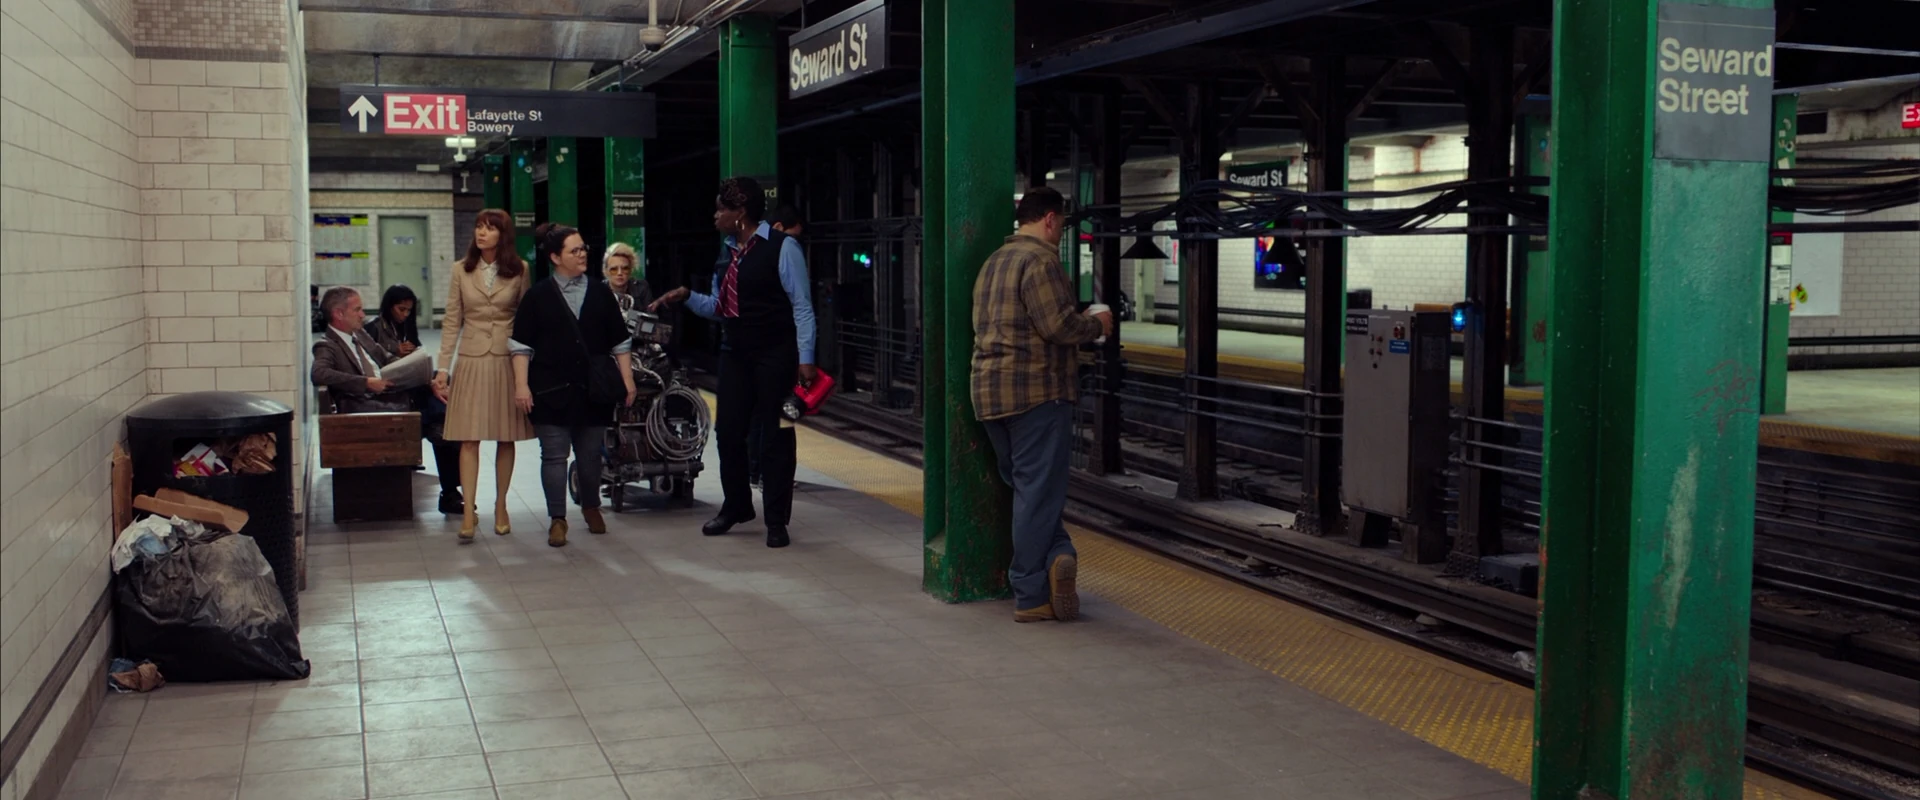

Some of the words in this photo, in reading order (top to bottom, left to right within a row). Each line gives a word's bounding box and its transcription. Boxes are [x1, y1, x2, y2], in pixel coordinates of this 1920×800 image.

[790, 30, 845, 91] Seward
[849, 23, 868, 71] St
[1659, 37, 1773, 77] Seward
[1658, 78, 1750, 115] Street
[386, 96, 461, 130] Exit
[467, 109, 525, 123] Lafayette
[529, 110, 543, 122] St
[467, 121, 515, 135] Bowery
[1270, 169, 1283, 187] St
[612, 199, 644, 208] Seward
[612, 207, 638, 216] Street
